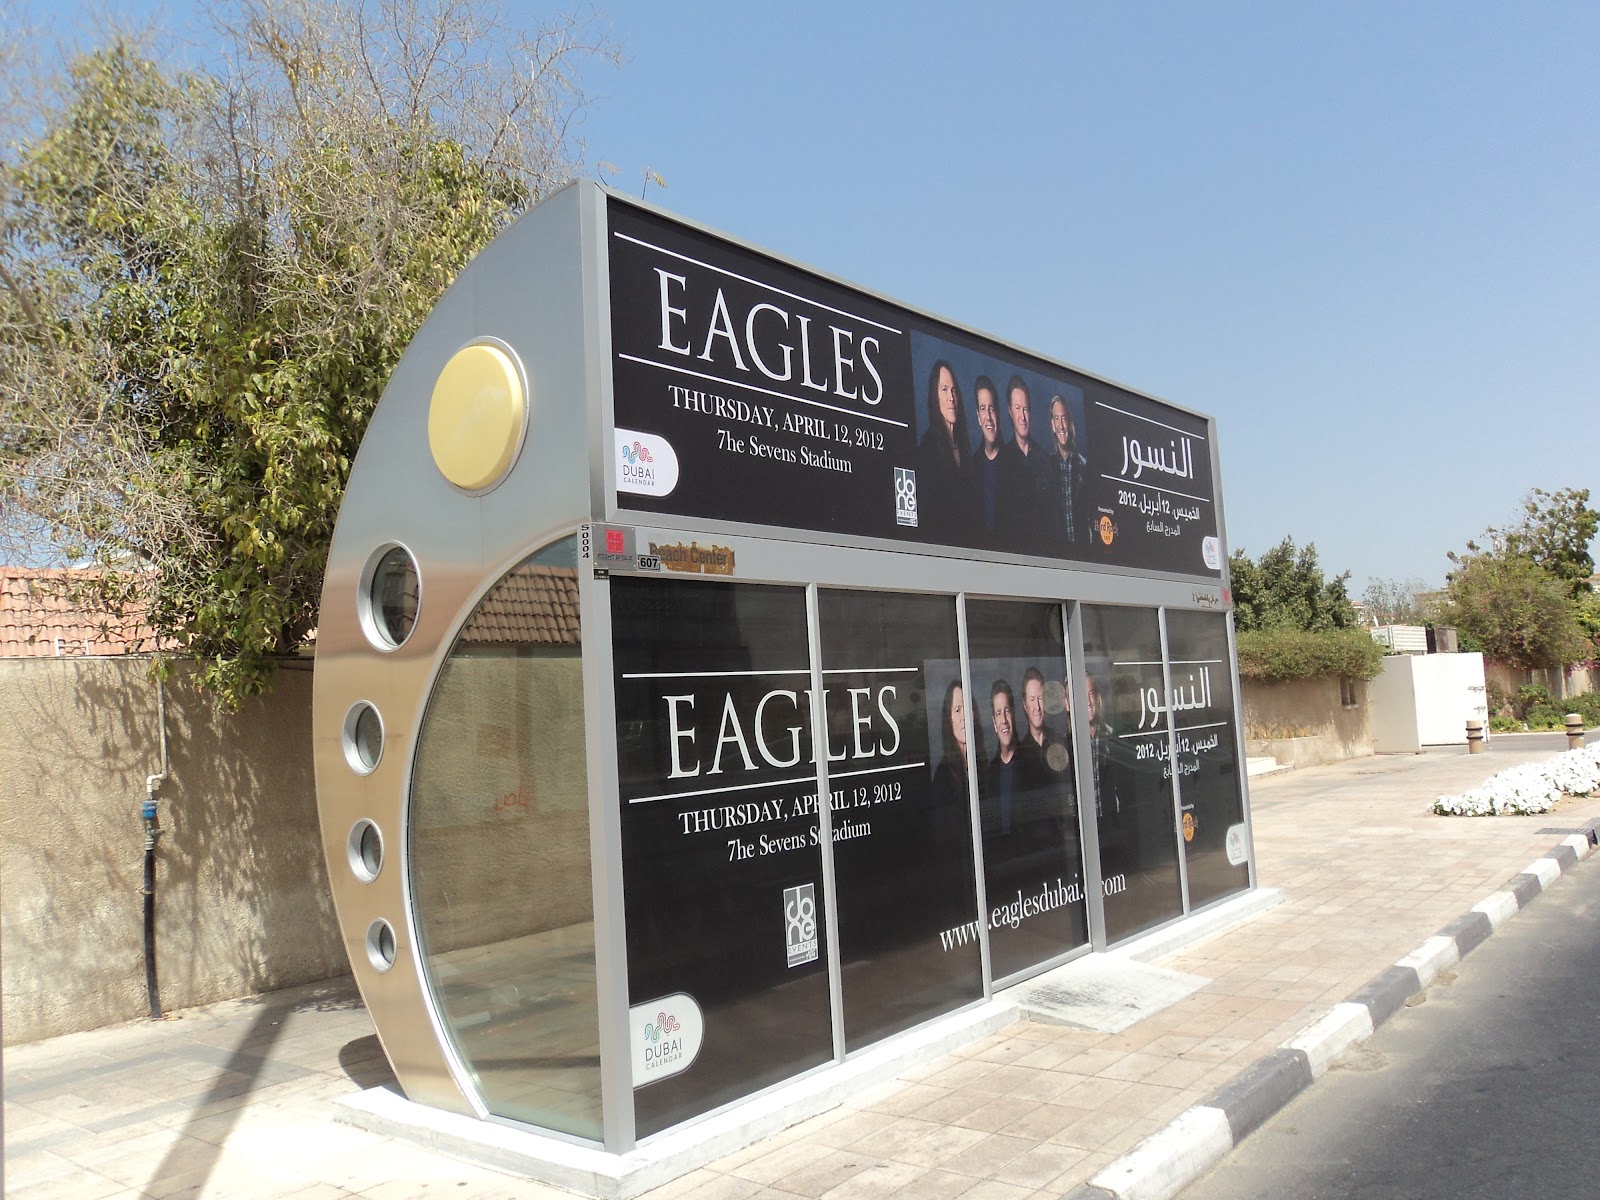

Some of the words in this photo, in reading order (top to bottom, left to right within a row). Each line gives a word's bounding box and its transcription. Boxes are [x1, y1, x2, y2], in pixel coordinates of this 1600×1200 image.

[653, 267, 884, 406] EAGLES
[668, 385, 780, 432] THURSDAY,
[782, 412, 831, 440] APRIL
[833, 424, 852, 446] 12,
[855, 429, 885, 451] 2012
[749, 436, 797, 463] Sevens
[800, 448, 853, 473] Stadium
[1121, 436, 1194, 480] النسور
[623, 465, 655, 480] DUBAI
[623, 477, 655, 487] CALENDAR
[1119, 490, 1137, 507] 2012
[897, 509, 917, 518] EVENTS
[640, 558, 658, 568] 607
[662, 685, 901, 780] EAGLES
[1136, 743, 1155, 760] 2012
[678, 799, 788, 834] THURSDAY,
[853, 787, 871, 808] 12,
[873, 781, 902, 804] 2012
[759, 833, 806, 856] Sevens
[788, 941, 817, 955] EVENTS
[645, 1037, 682, 1062] DUBAI
[645, 1052, 682, 1070] CALENDAR
